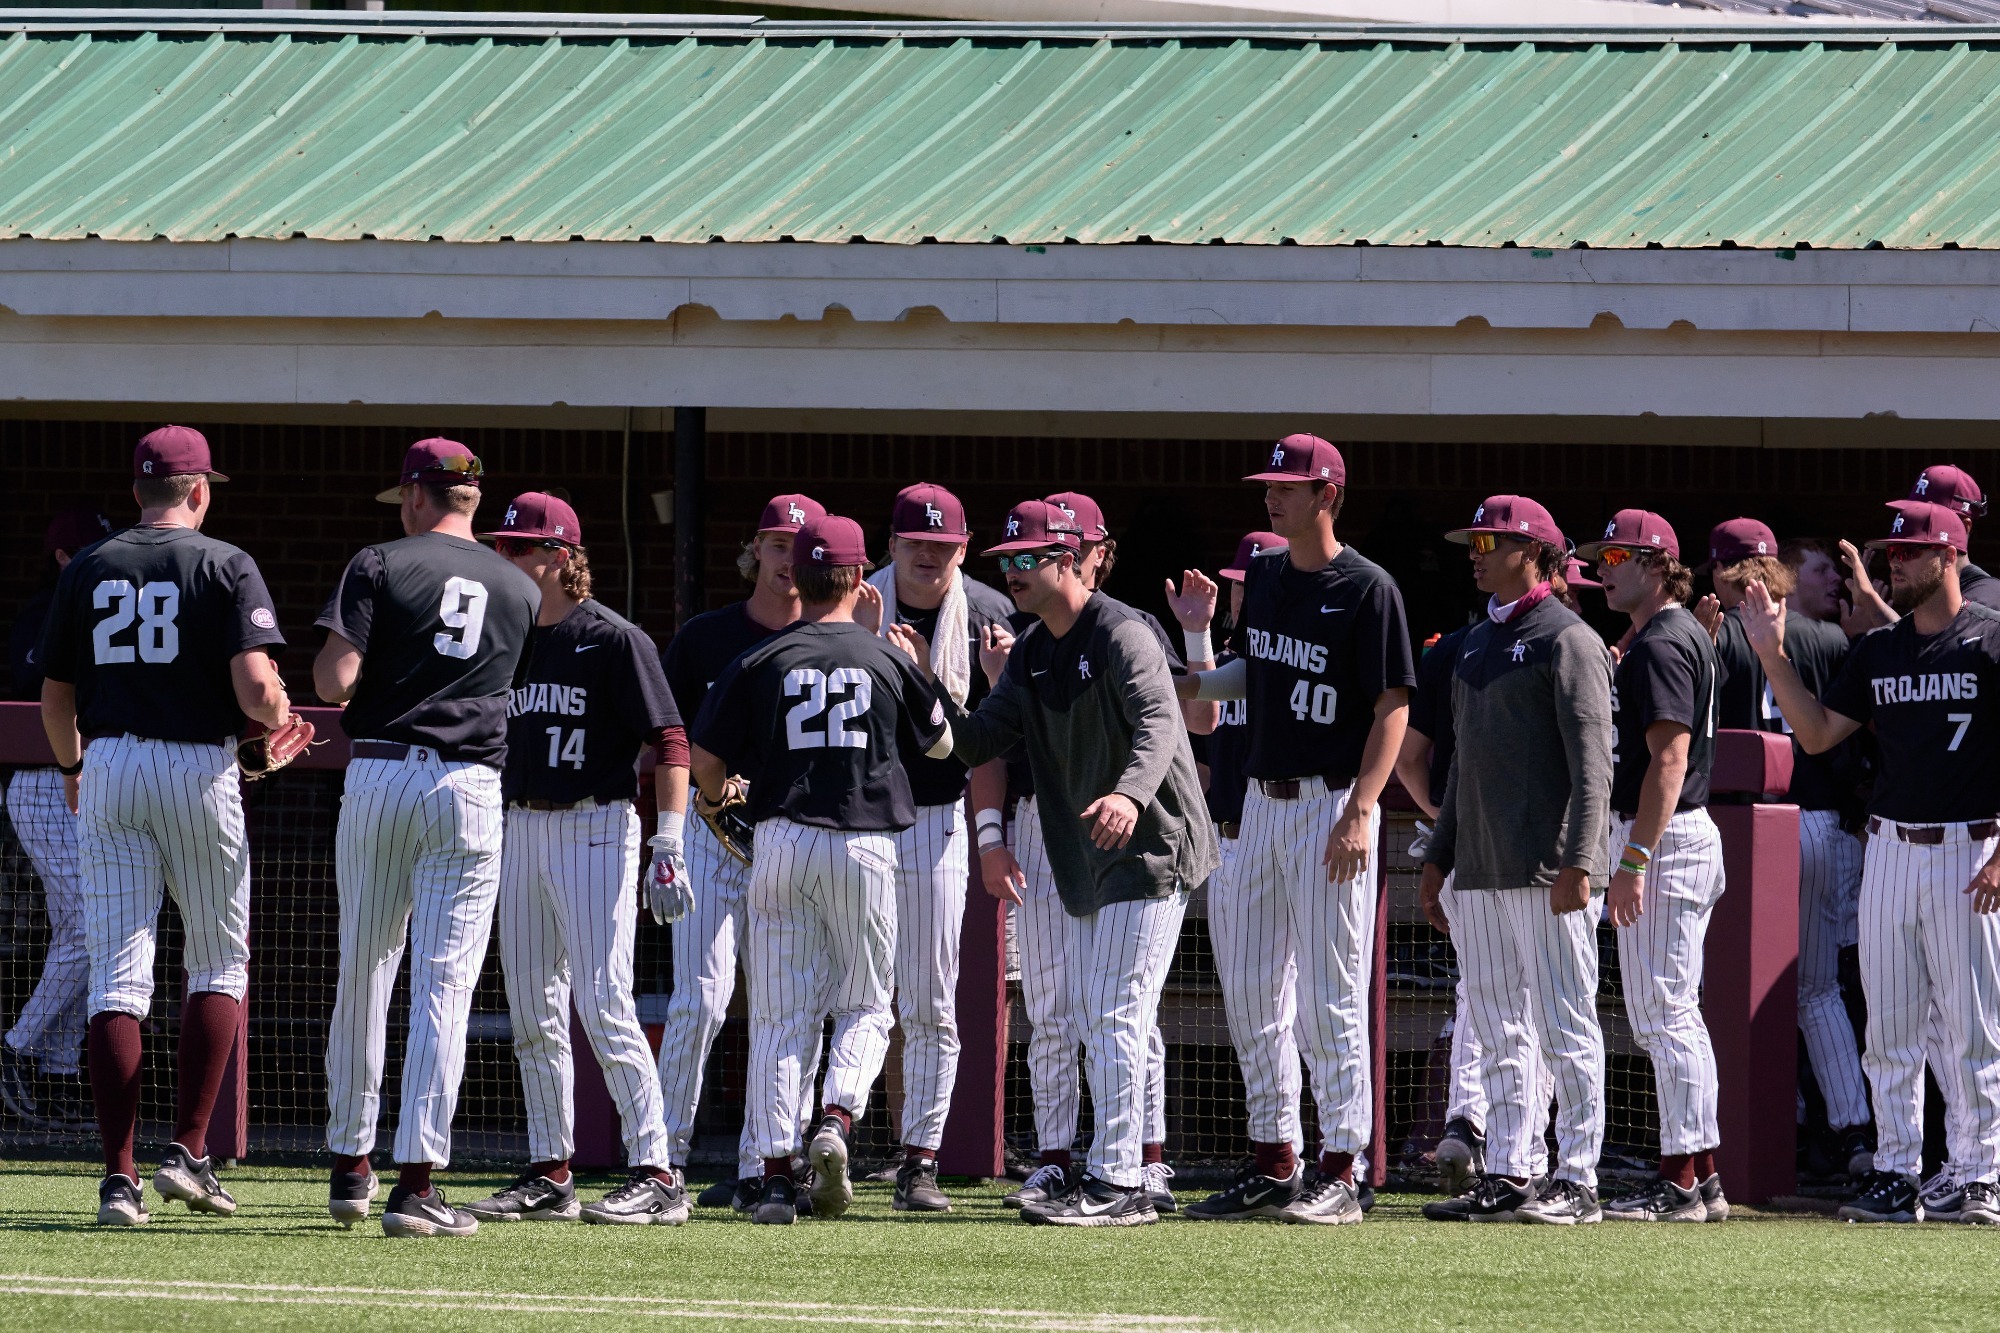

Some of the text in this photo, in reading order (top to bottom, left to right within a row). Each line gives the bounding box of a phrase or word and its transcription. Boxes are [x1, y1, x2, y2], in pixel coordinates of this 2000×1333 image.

[789, 502, 805, 525] LR
[925, 502, 943, 527] LR
[1006, 515, 1019, 537] LR
[1250, 543, 1260, 557] L
[92, 579, 180, 664] 28
[433, 576, 489, 660] 9
[506, 683, 587, 719] ROJANS
[1290, 679, 1337, 724] 40
[1871, 672, 1978, 705] TROJANS
[784, 668, 872, 751] 22
[545, 726, 586, 769] 14
[1947, 713, 1972, 751] 7
